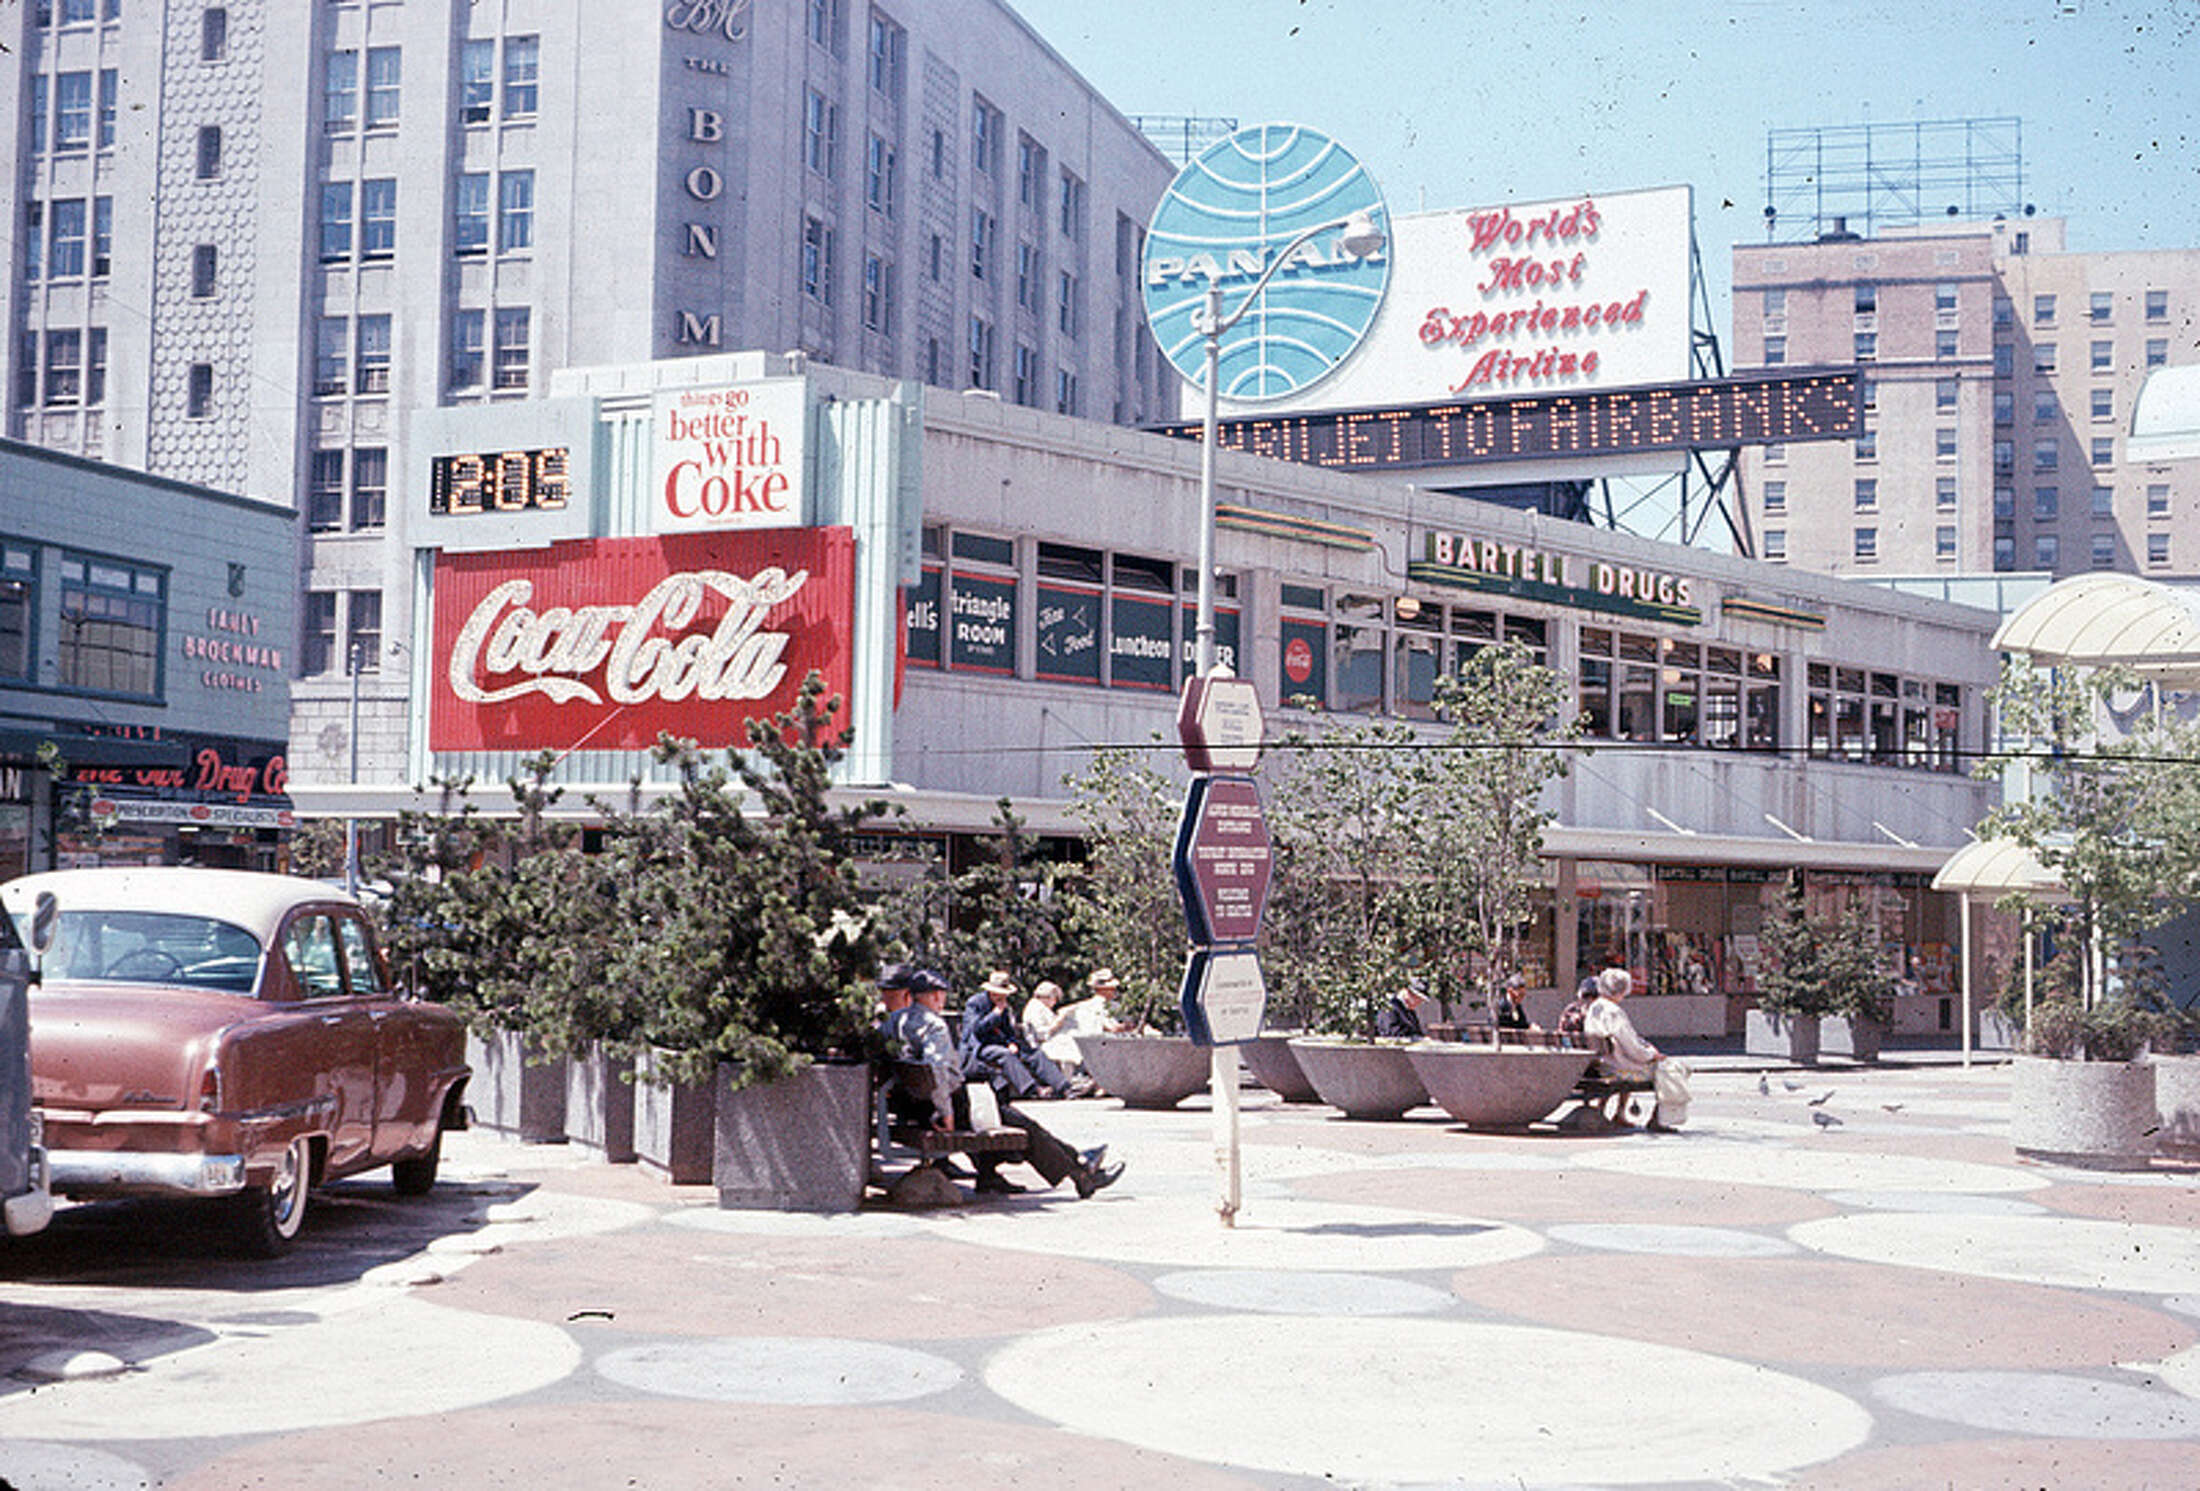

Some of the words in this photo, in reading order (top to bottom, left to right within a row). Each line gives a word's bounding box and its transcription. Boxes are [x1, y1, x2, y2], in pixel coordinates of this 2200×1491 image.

[684, 108, 723, 258] BON
[1465, 201, 1602, 253] World's
[1149, 247, 1274, 285] PAN
[1477, 252, 1587, 294] Most
[1418, 289, 1649, 346] Experienced
[1448, 346, 1599, 394] Airline
[670, 409, 749, 441] better
[725, 390, 750, 412] go
[1319, 411, 1412, 465] JET
[1429, 404, 1495, 458] TO
[1510, 376, 1857, 453] FAIRBANKS
[703, 420, 782, 468] with
[665, 459, 789, 519] Coke
[1433, 531, 1579, 588] BARTELL
[1597, 562, 1693, 607] DRUGS
[950, 589, 1011, 625] triangle
[184, 635, 282, 671] BROCKMAN
[957, 622, 1006, 645] ROOM
[1109, 632, 1171, 658] Luncheon
[1183, 640, 1234, 666] DER
[196, 748, 256, 804] Drug
